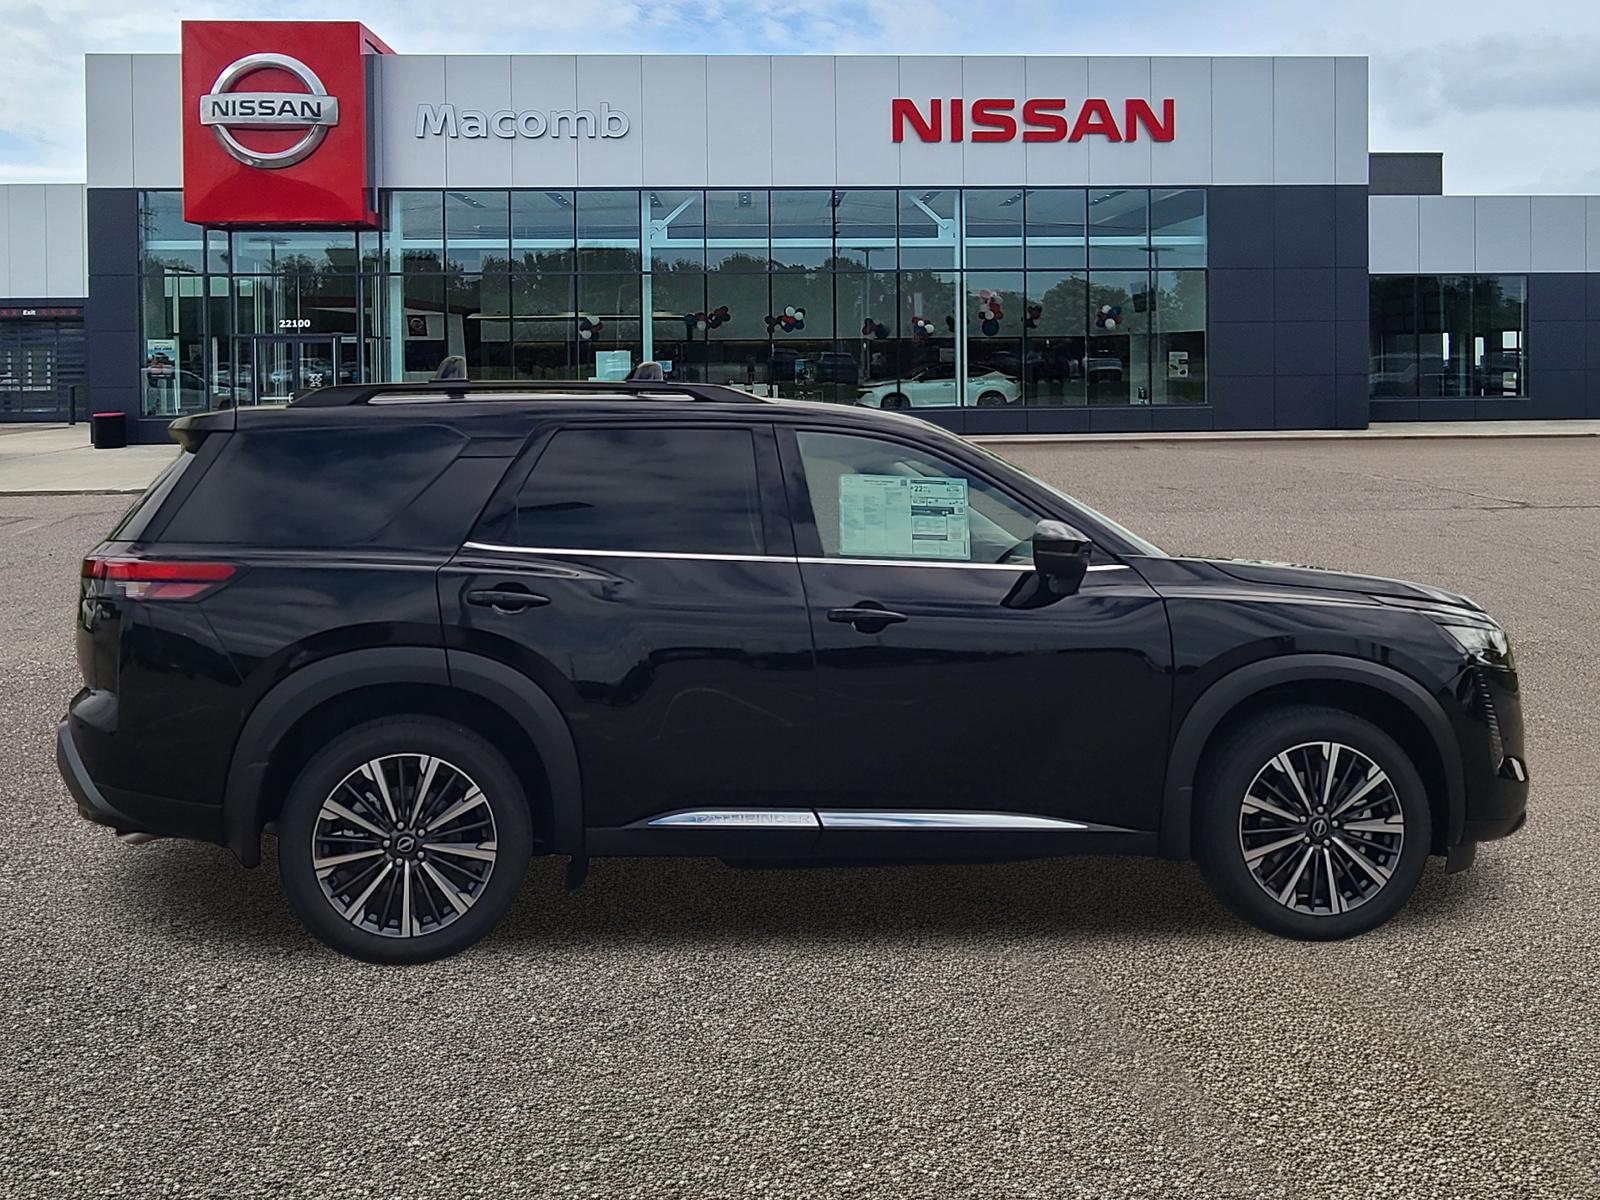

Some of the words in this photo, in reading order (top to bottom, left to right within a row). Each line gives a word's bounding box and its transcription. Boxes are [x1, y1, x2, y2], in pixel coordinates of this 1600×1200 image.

[211, 100, 322, 118] NISSAN
[415, 102, 630, 139] Macomb
[892, 98, 1175, 143] NISSAN
[279, 319, 311, 328] 22100
